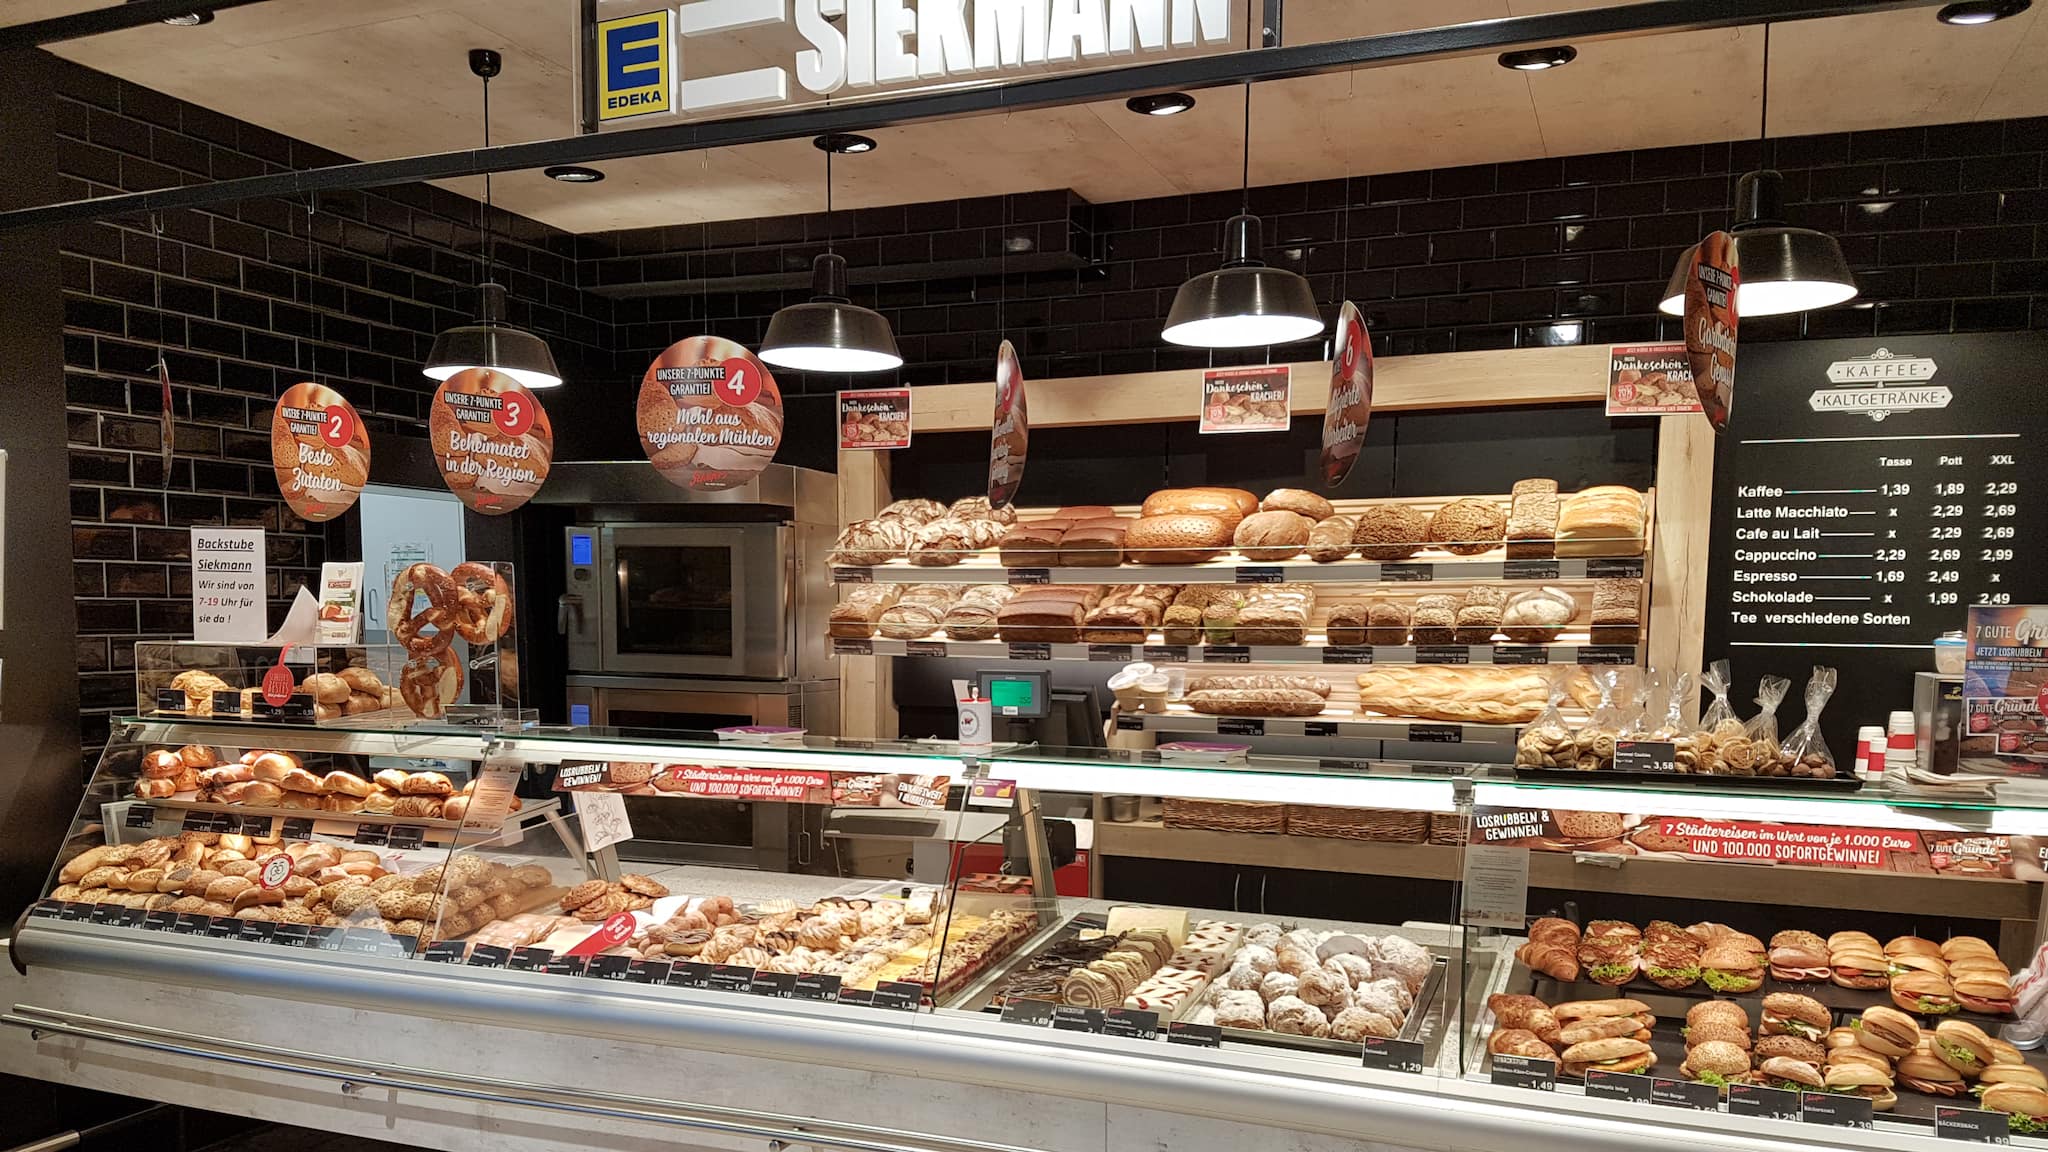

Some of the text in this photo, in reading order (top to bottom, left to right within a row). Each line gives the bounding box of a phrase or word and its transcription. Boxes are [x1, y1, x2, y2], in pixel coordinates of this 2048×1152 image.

[607, 91, 662, 109] EDEKA
[1346, 335, 1354, 367] 6
[1612, 358, 1689, 372] Dankeschön-
[1846, 364, 1918, 378] KAFFEE
[656, 367, 725, 381] UNSERE 7-PUNKTE
[1666, 370, 1694, 382] KRACH
[670, 382, 711, 396] GARANTIE!
[727, 369, 745, 396] 4
[1206, 380, 1269, 394] Dankeschön-
[444, 392, 503, 410] UNSERE 7-PUNKTE
[1250, 390, 1285, 401] KRACHER!
[1822, 390, 1939, 407] KALTGETRÄNKE
[282, 407, 328, 423] UNSERE 7-PUNKTE
[456, 409, 490, 423] GARANTIE!
[504, 402, 520, 427] 3
[676, 407, 741, 426] Mehl aus
[328, 415, 343, 439] 2
[450, 431, 531, 460] Beheimatet
[647, 430, 775, 450] regionalen Mühlen
[299, 442, 335, 466] Beste
[1879, 455, 2015, 467] Tasse Pott XXL
[445, 453, 536, 487] in der Region
[292, 467, 343, 492] Zutaten
[1737, 483, 2018, 498] Kaffee 1,39 1,89 2,29
[1736, 506, 1772, 519] Latte
[1775, 506, 1848, 518] Macchiato
[1932, 505, 1964, 517] 2,29
[1985, 504, 2016, 517] 2,69
[1735, 528, 1768, 540] Cafe
[1771, 530, 1790, 540] au
[1793, 528, 1820, 540] Lait
[1931, 527, 1962, 540] 2,29
[1983, 527, 2015, 540] 2,69
[197, 538, 255, 551] Backstube
[1734, 550, 2014, 564] Cappuccino 2,29 2,69 2,99
[197, 559, 252, 571] Siekmann
[198, 580, 215, 589] Wir
[216, 581, 236, 590] sind
[1733, 571, 1798, 585] Espresso
[1876, 571, 1905, 584] 1,69
[1928, 571, 1960, 584] 2,49
[199, 597, 254, 609] 7-19 Uhr für
[1732, 591, 1814, 604] Schokolade
[1928, 592, 1958, 605] 1,99
[1979, 592, 2011, 605] 2,49
[199, 614, 211, 623] sie
[213, 614, 225, 623] da
[1731, 612, 1911, 625] Tee verschiedene Sorten
[1975, 626, 1982, 638] 7
[1985, 625, 2011, 639] GUTE
[1976, 647, 2042, 657] JETZT LOSRUBBELN
[1975, 703, 1994, 713] GUTE
[1994, 699, 2041, 716] Gründe
[560, 763, 601, 778] LOSRUBBELN
[690, 782, 706, 792] UND
[707, 783, 738, 794] 100.000
[1476, 810, 1550, 828] LOSRUBBELN &
[1485, 825, 1543, 841] GEWINNEN!
[1665, 822, 1913, 849] 7 Städtereisen im Wert von je 1.000 Euro
[1692, 840, 1880, 864] UND 100.000 SOFORTGEWINNE!
[1953, 841, 1998, 856] Gründe
[1137, 1029, 1155, 1039] 2,49
[1401, 1061, 1422, 1072] 1,29
[1531, 1079, 1553, 1091] 1,49
